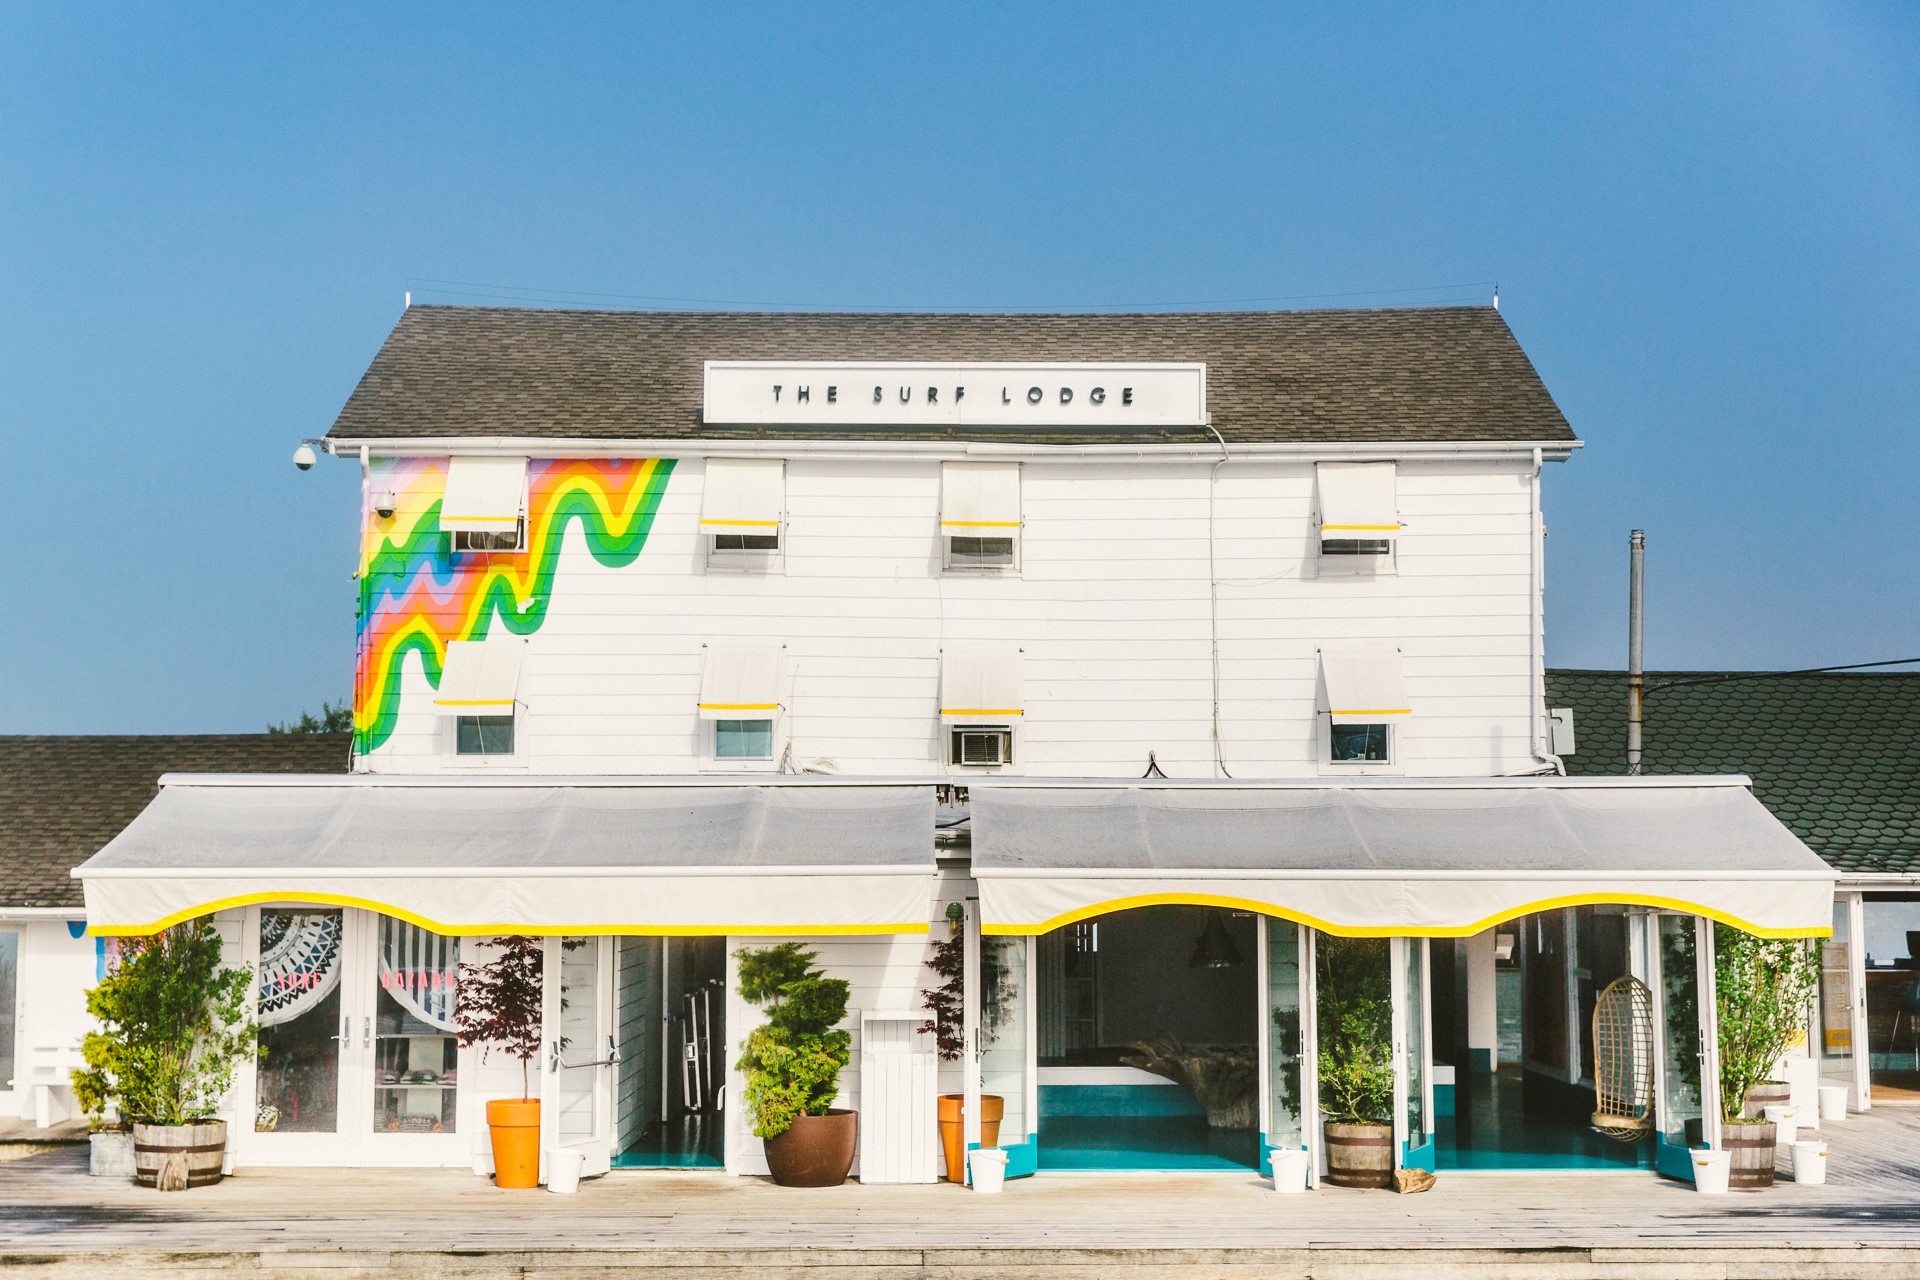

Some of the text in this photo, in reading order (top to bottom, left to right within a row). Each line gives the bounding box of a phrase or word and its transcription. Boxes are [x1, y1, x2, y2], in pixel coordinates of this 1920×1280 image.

[773, 385, 1133, 404] THE SURF LODGE
[277, 971, 455, 988] SURF BAZAAR
